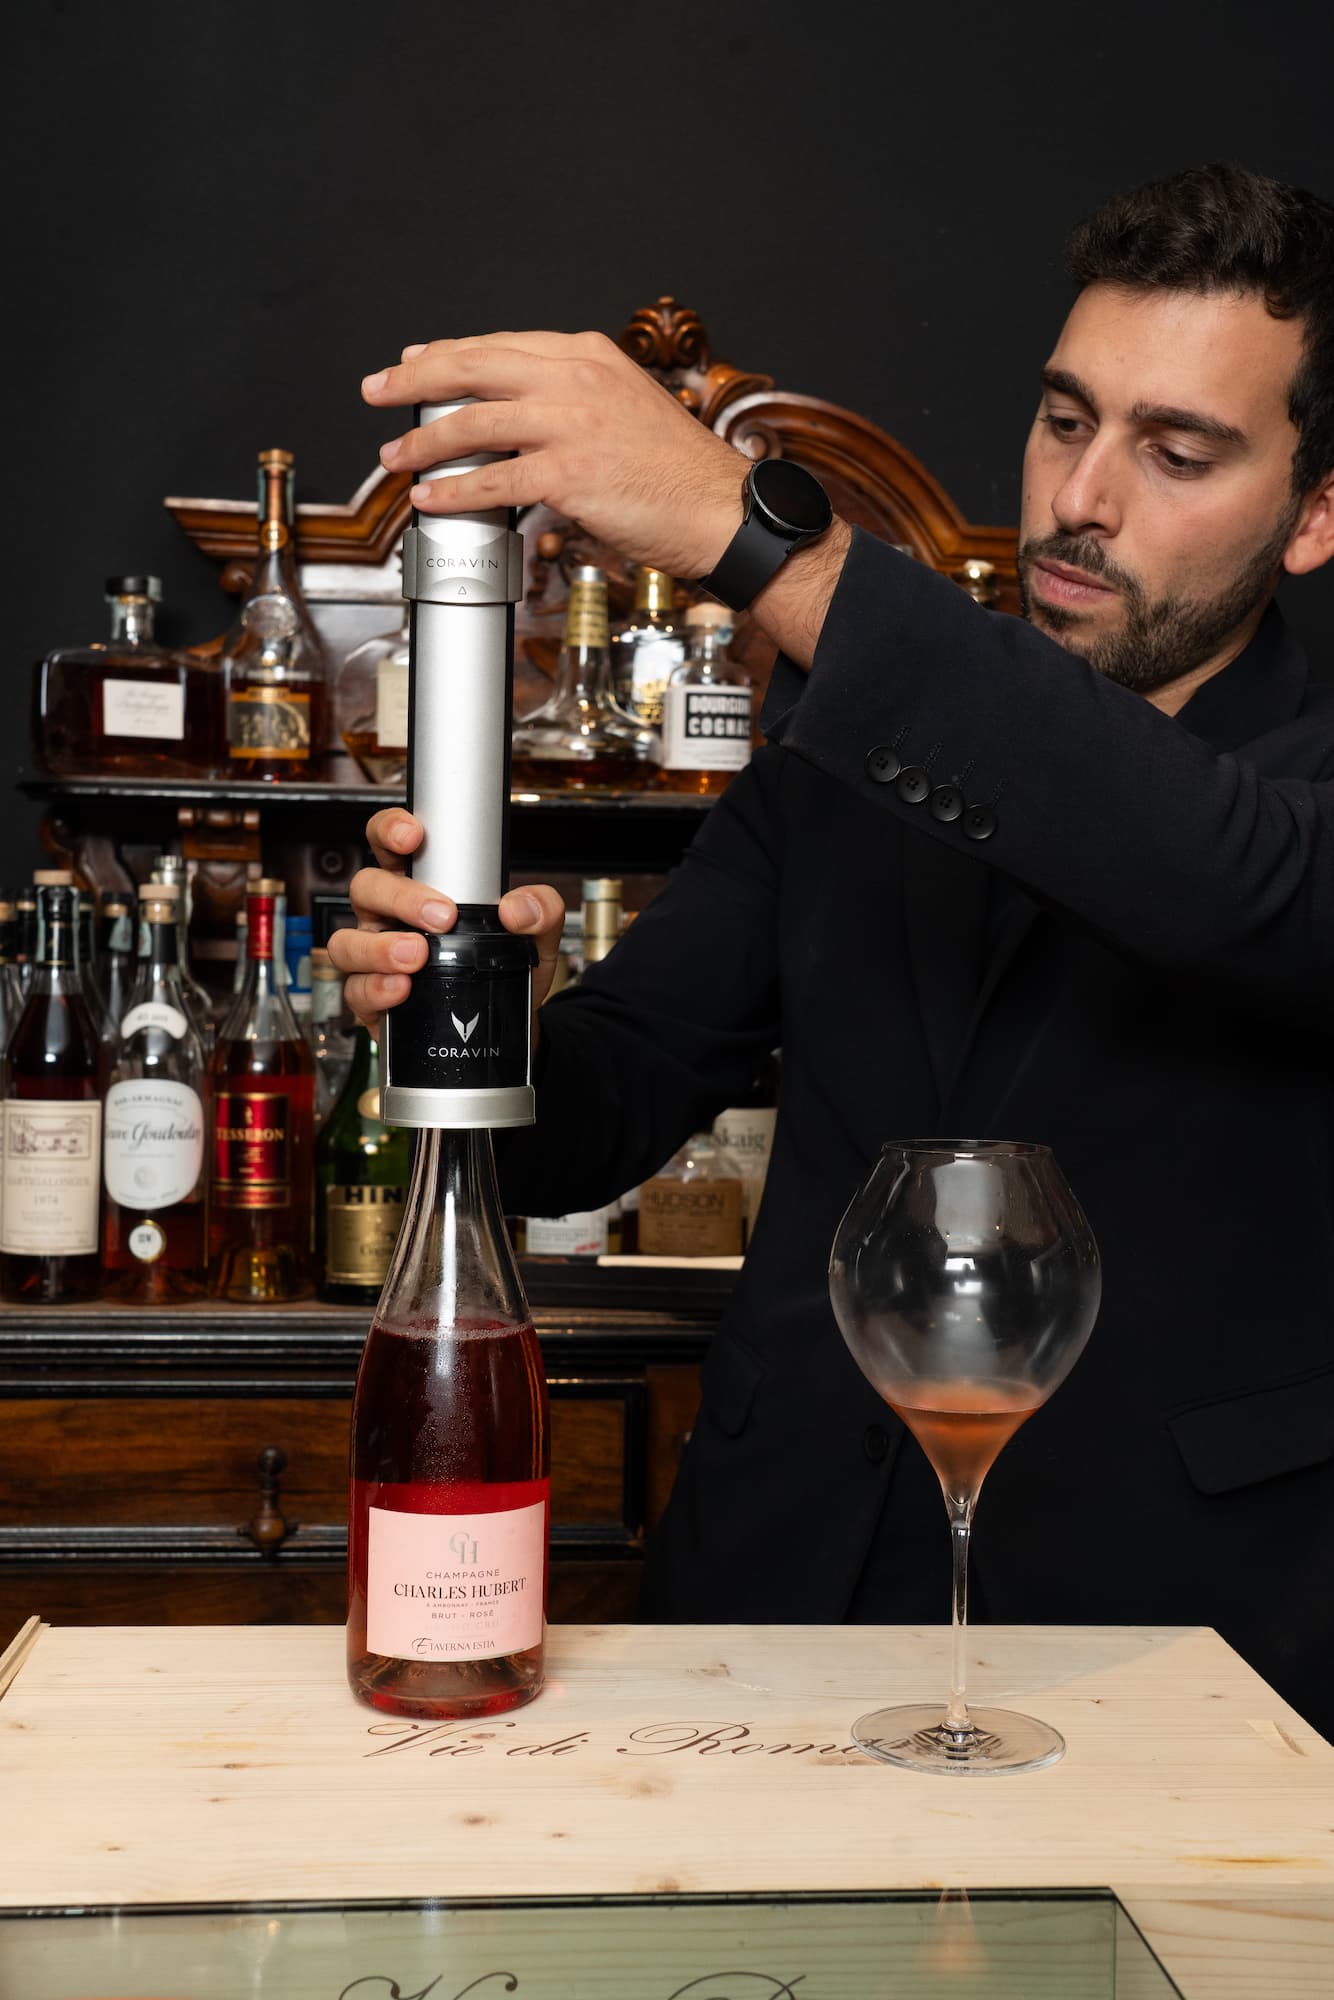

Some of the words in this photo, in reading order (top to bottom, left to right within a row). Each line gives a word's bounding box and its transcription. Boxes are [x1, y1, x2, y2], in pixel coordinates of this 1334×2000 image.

[426, 558, 499, 569] CORAVIN
[427, 1046, 500, 1058] CORAVIN
[345, 1185, 403, 1204] HIN
[426, 1569, 501, 1580] CHAMPAGNE
[394, 1583, 467, 1600] CHARLES
[472, 1577, 527, 1599] HUBERT
[431, 1612, 457, 1620] BRUT
[469, 1609, 495, 1619] ROSÉ
[361, 1721, 517, 1758] Vie
[505, 1731, 592, 1757] di
